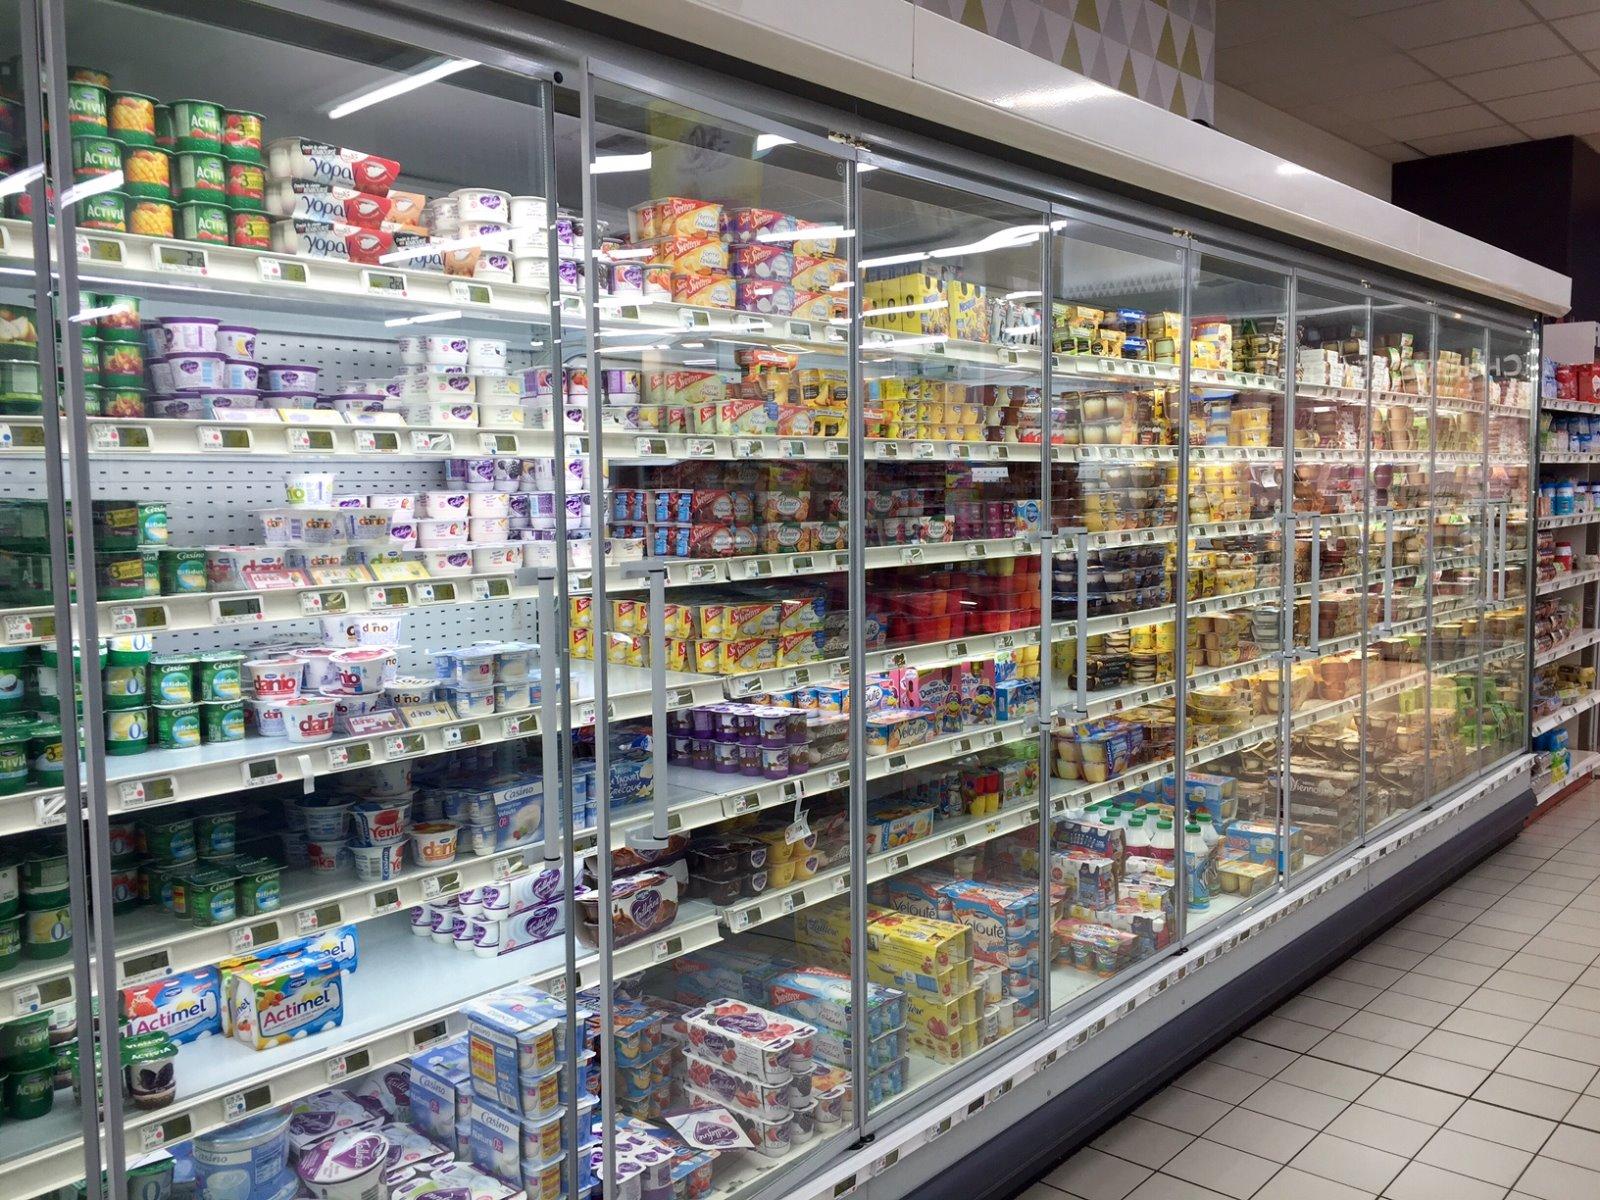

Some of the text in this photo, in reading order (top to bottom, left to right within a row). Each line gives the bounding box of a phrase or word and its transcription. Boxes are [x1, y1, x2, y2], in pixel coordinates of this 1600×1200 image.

[503, 786, 534, 800] Casino
[894, 900, 937, 919] Velouté
[136, 998, 207, 1036] Actimel
[264, 989, 330, 1029] Actimel
[481, 1111, 510, 1134] Casino
